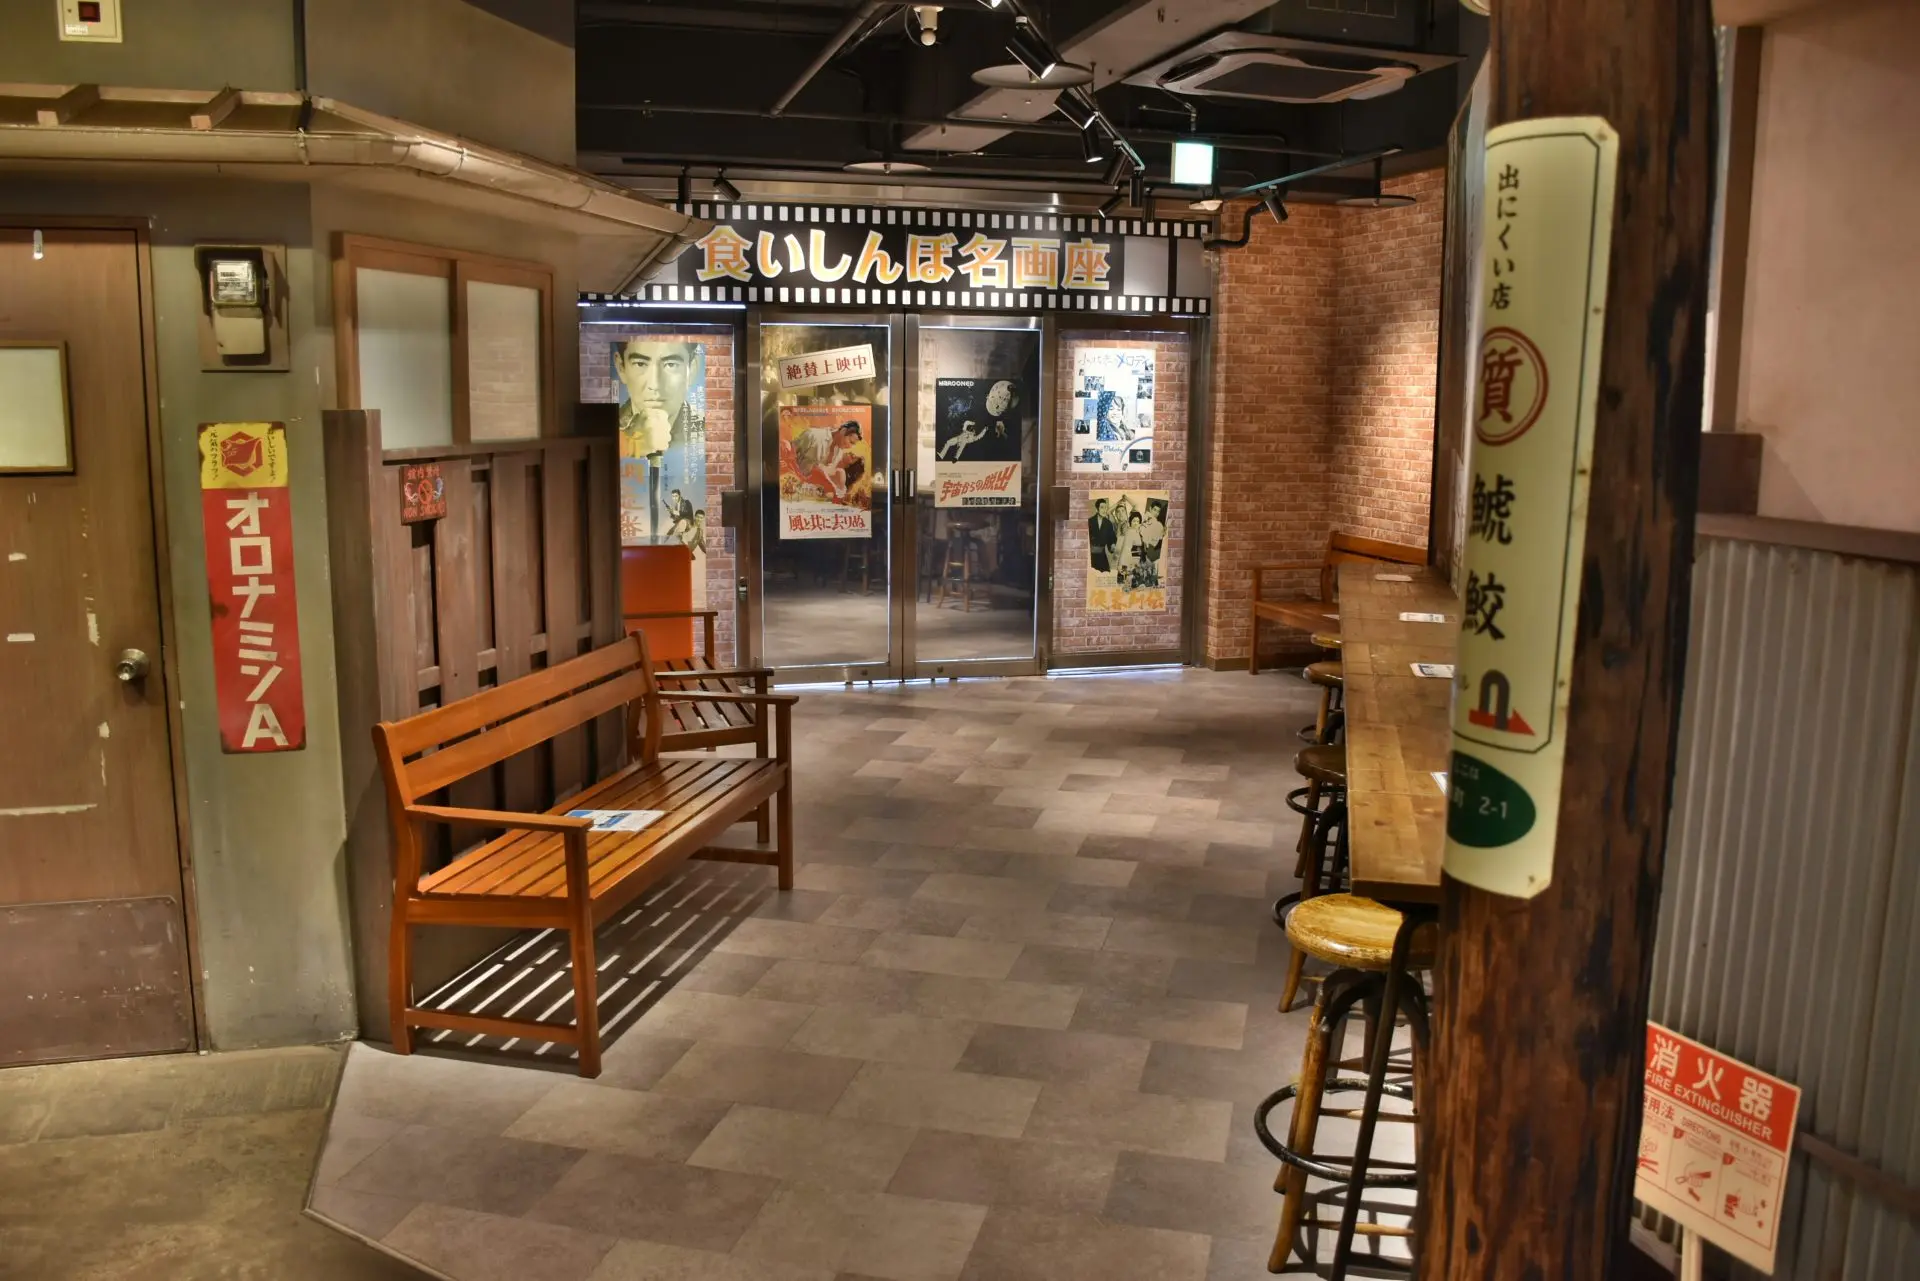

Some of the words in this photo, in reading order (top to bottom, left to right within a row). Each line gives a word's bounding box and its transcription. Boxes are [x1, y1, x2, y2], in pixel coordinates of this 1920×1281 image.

[695, 224, 1112, 291] 食いしんぼ名画座
[1488, 163, 1520, 311] 出にくい店
[786, 354, 867, 380] 絶賛上映中
[1477, 345, 1525, 425] 質
[940, 463, 1018, 503] 宇宙からの脱出
[788, 513, 866, 532] 風と共に去りぬ
[225, 491, 290, 748] オロナミンA
[1478, 796, 1508, 820] 2-1
[1646, 1071, 1672, 1092] FIRE
[1674, 1085, 1773, 1141] EXTINGUISHER
[1650, 1034, 1774, 1122] 消火器
